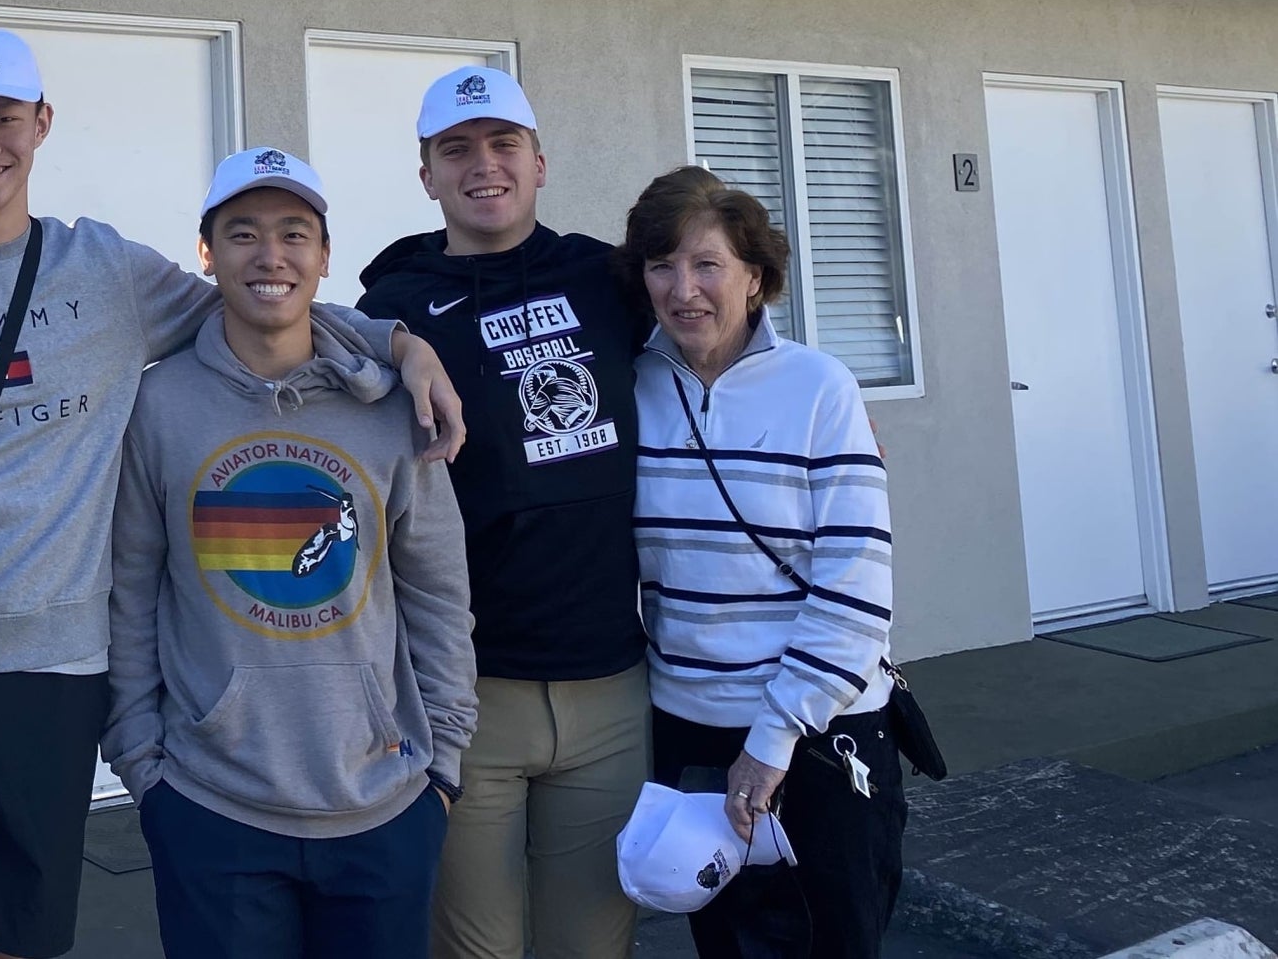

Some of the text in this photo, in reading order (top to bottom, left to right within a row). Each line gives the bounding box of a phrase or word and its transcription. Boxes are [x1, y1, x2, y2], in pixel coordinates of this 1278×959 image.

[962, 158, 975, 186] 2
[485, 304, 568, 340] CHAFFEY
[502, 336, 580, 369] BASEBALL
[536, 438, 569, 458] EST.
[210, 442, 353, 488] AVIATOR NATION
